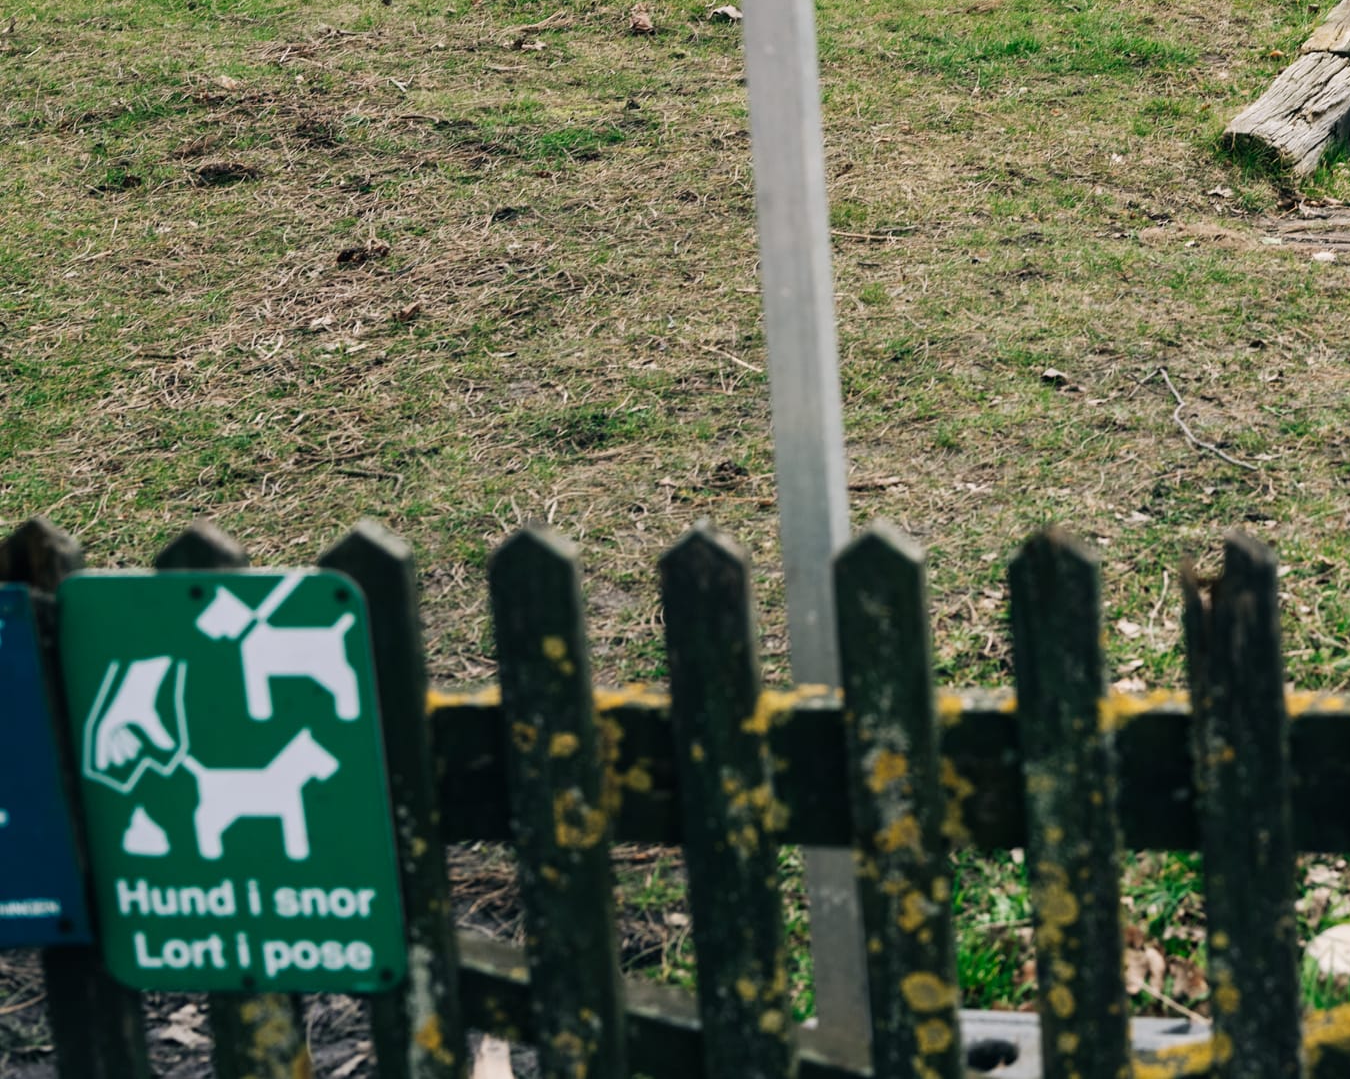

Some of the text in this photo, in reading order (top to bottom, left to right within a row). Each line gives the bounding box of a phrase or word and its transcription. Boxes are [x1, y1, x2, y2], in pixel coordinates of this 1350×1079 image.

[116, 879, 376, 917] Hund i snor
[135, 931, 374, 977] Lort i pose
